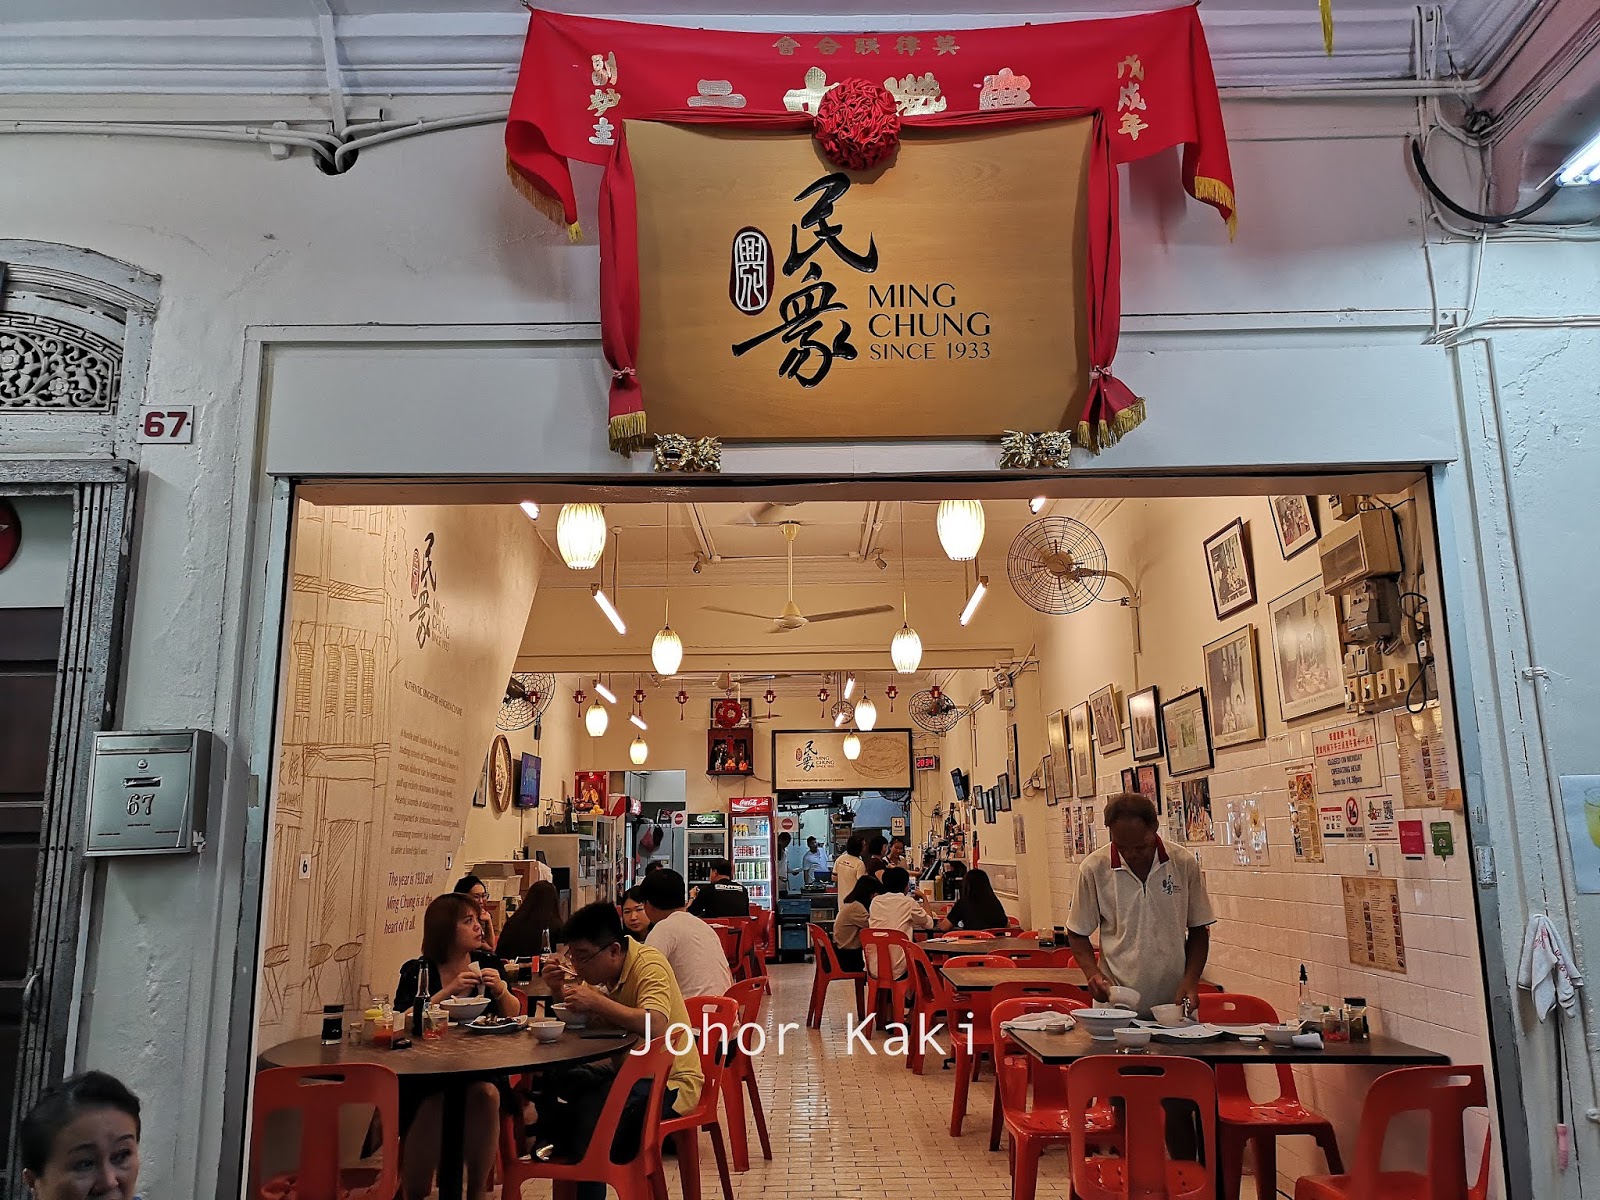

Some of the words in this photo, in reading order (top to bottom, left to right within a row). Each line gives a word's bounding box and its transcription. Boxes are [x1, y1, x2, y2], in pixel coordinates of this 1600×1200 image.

[868, 283, 956, 308] MING
[868, 312, 990, 338] CHUNG
[869, 343, 936, 360] SINCE
[947, 341, 991, 360] 1933
[144, 411, 188, 438] 67
[127, 793, 155, 816] 67
[1368, 852, 1375, 866] 1
[388, 872, 398, 886] The
[386, 896, 400, 914] Ming
[400, 894, 416, 912] Chung
[384, 919, 399, 935] heart
